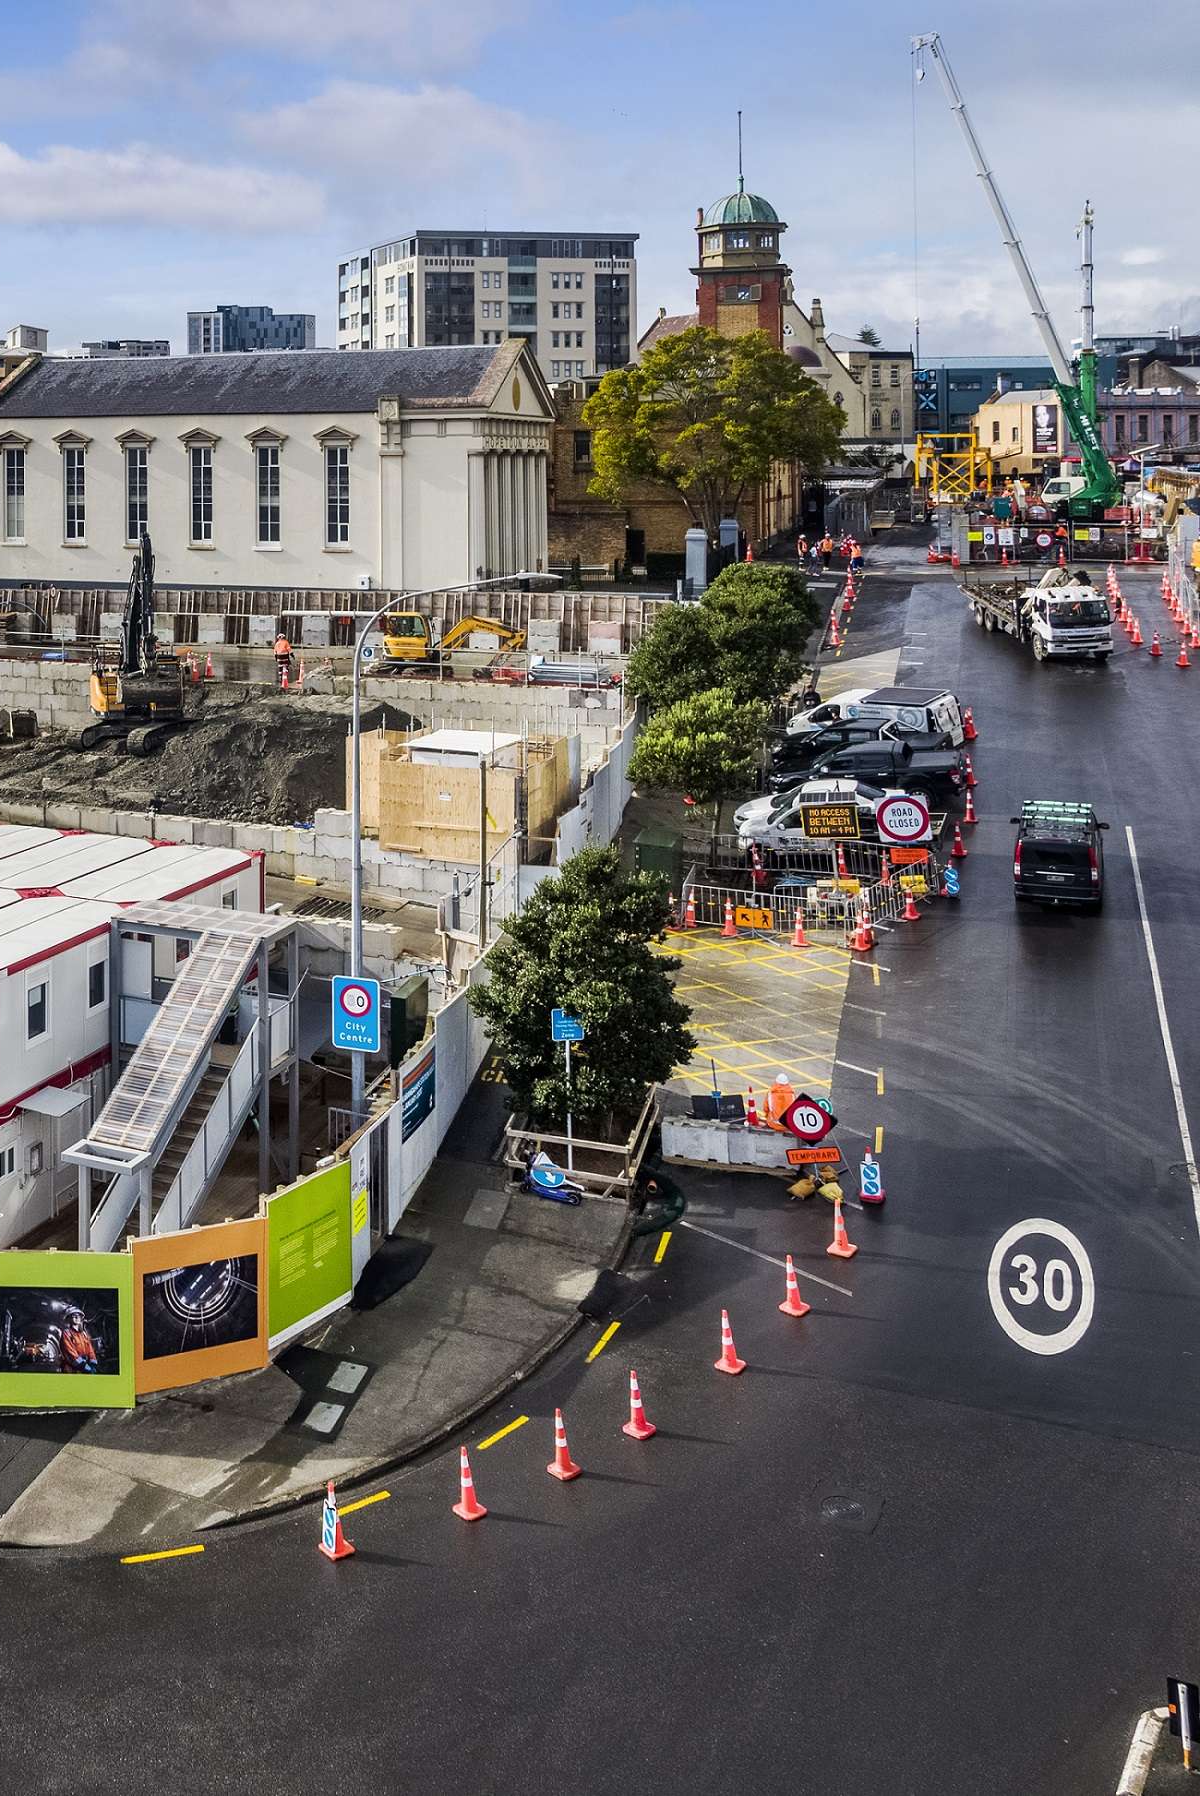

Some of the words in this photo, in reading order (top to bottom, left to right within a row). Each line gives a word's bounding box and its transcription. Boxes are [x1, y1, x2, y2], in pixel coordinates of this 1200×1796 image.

[809, 808, 820, 817] NO
[821, 808, 850, 816] ACCESS
[891, 807, 913, 817] ROAD
[809, 817, 851, 826] BETWEEN
[888, 818, 920, 828] CLOSED
[345, 1022, 366, 1033] City
[340, 1032, 373, 1044] Centre
[800, 1113, 818, 1127] 10
[791, 1151, 836, 1161] TEMPORARY
[1008, 1254, 1073, 1312] 30
